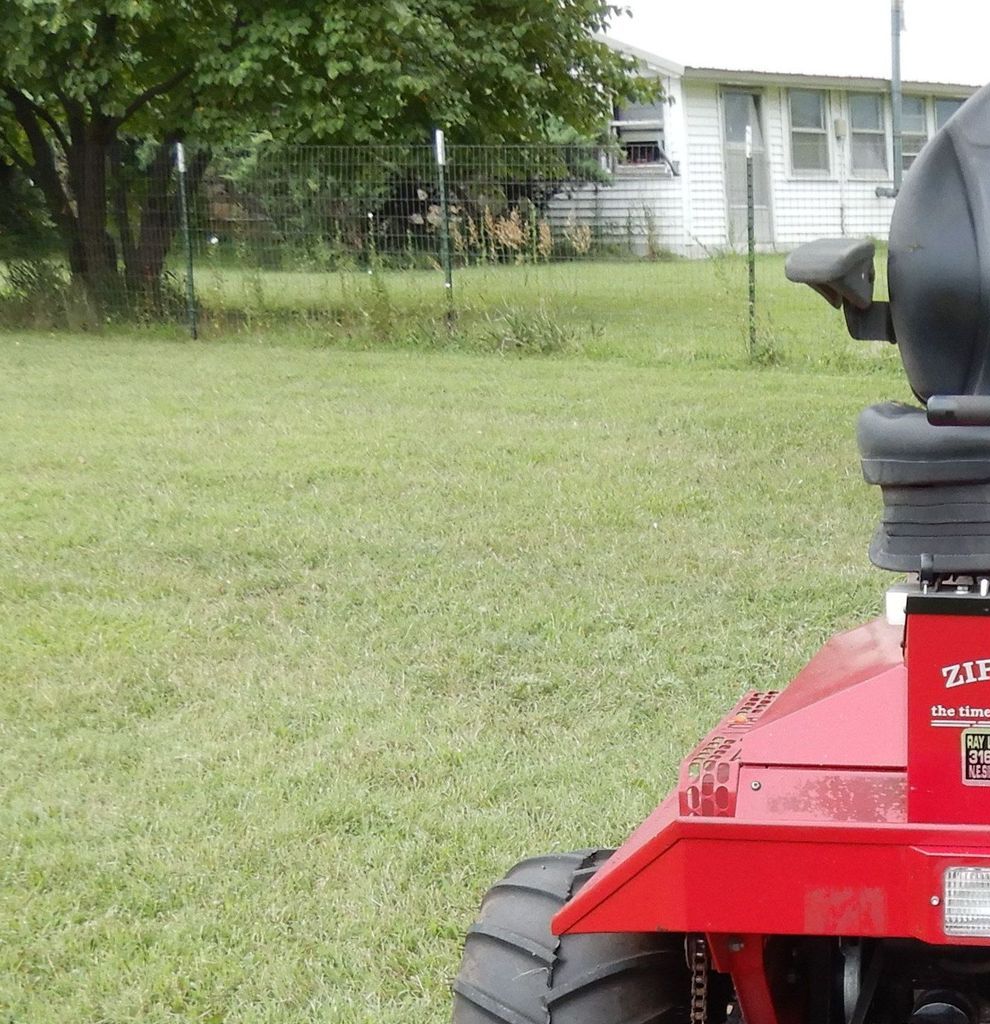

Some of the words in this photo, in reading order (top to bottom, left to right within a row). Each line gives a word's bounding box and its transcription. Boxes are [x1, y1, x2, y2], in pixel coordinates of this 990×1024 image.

[931, 705, 955, 717] the
[959, 705, 990, 718] time
[967, 735, 985, 749] RAY
